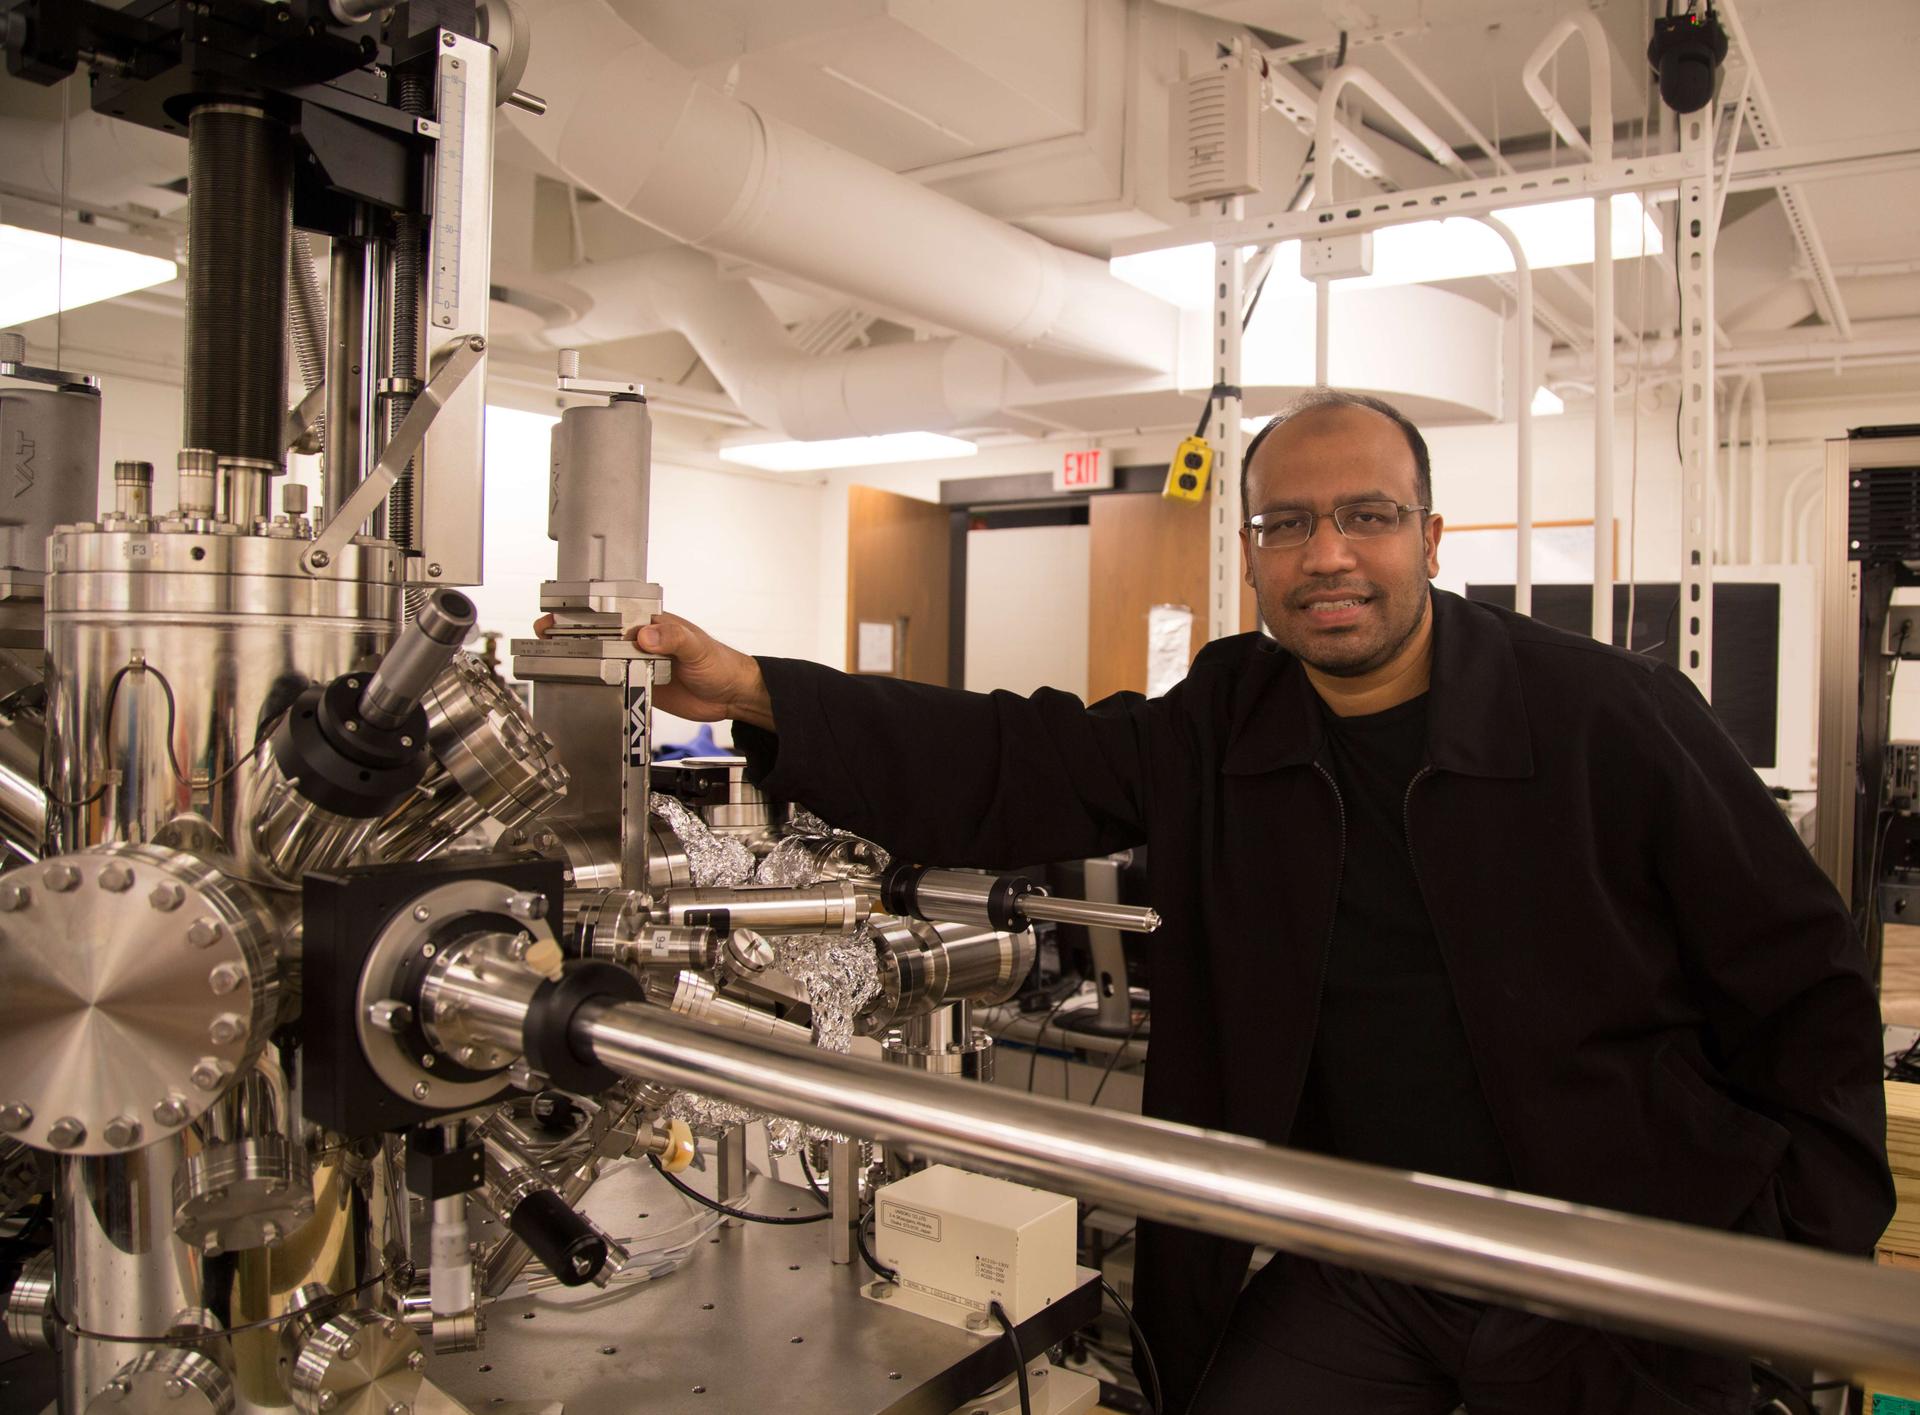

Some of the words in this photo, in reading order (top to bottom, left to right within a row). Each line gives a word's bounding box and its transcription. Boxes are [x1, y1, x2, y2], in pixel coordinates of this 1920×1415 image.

[445, 224, 454, 234] 50
[14, 429, 36, 498] VAT
[1063, 450, 1101, 486] EXIT
[131, 544, 147, 556] F3
[630, 689, 646, 765] VAT
[654, 935, 666, 950] F6
